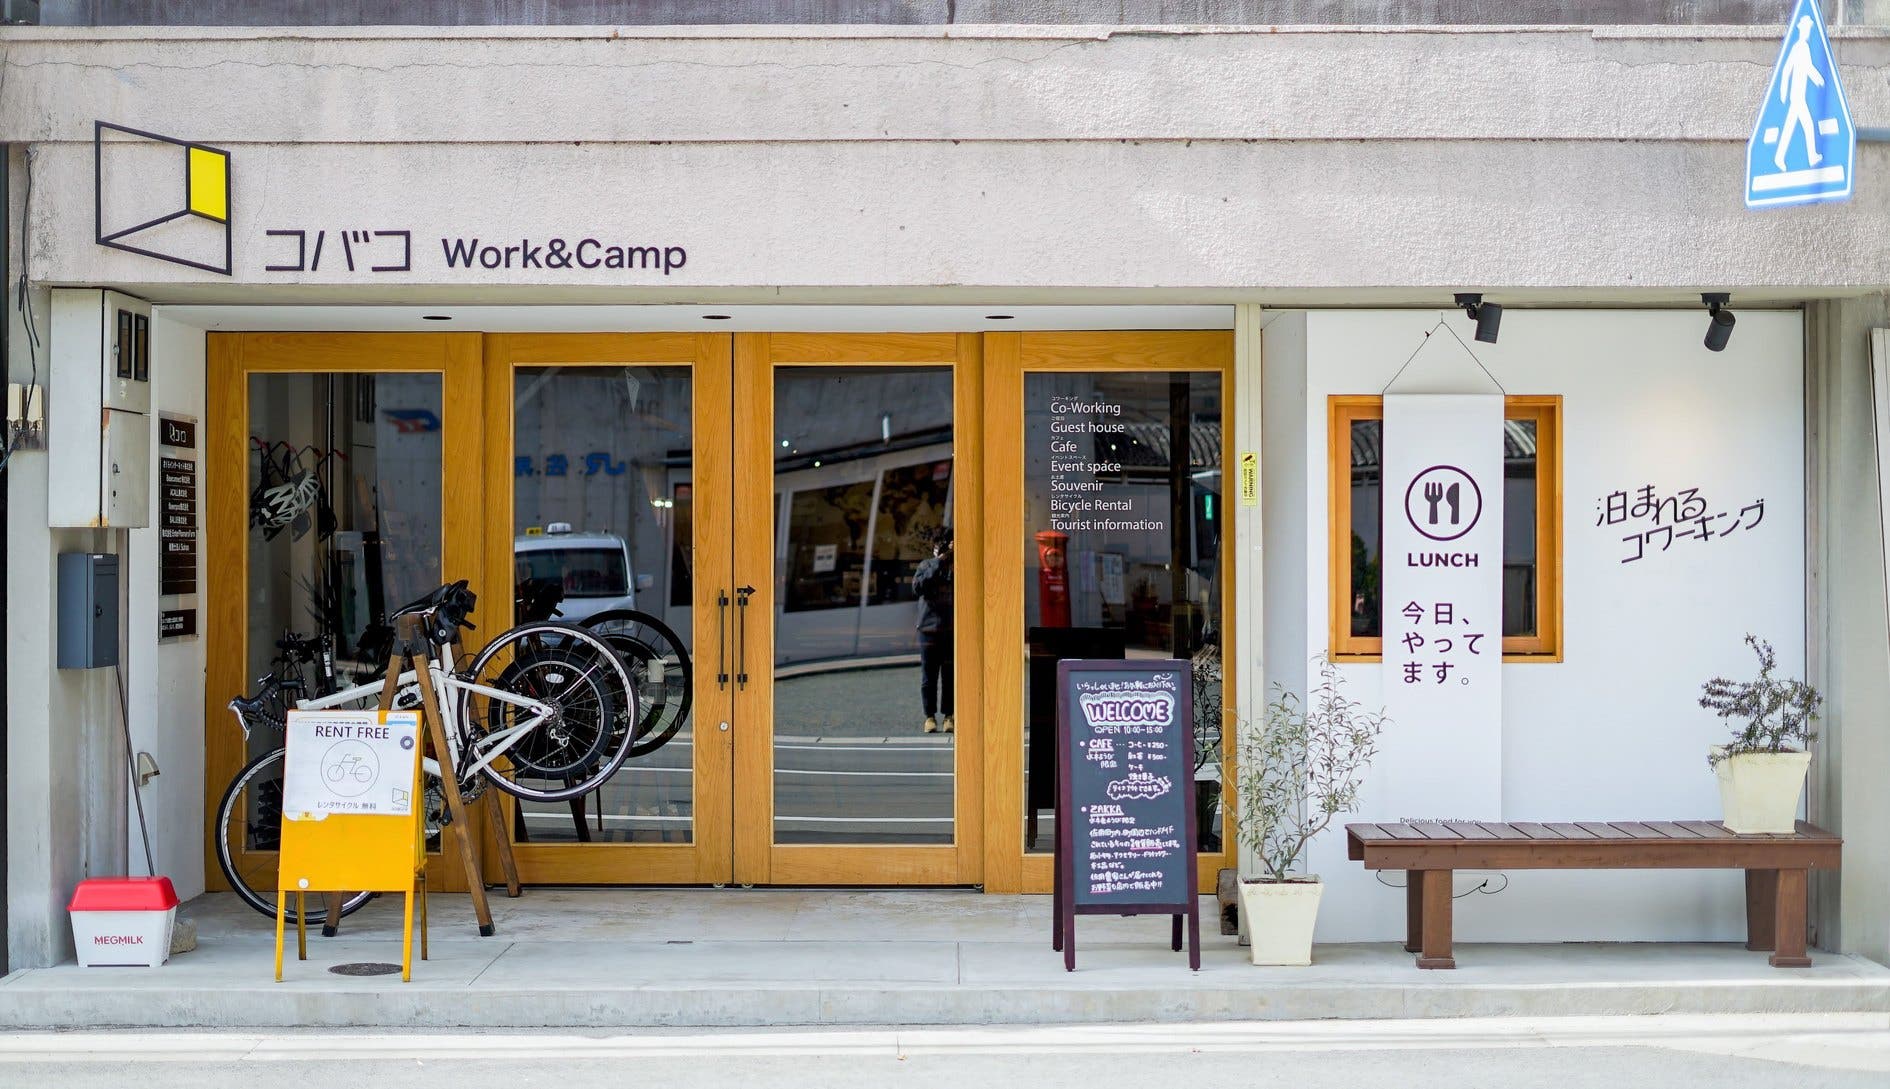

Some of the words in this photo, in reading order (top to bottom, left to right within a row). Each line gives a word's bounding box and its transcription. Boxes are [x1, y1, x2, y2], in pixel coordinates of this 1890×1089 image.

[266, 229, 411, 272] コバコ
[441, 237, 688, 275] Work&Camp
[1050, 402, 1121, 416] Co-Working
[1050, 421, 1085, 433] Guest
[1088, 421, 1125, 433] house
[1050, 441, 1077, 453] Cafe
[1051, 460, 1085, 472] Event
[1087, 462, 1121, 474] space
[1051, 480, 1104, 492] Souvenir
[1050, 499, 1092, 513] Bicycle
[1095, 499, 1132, 511] Rental
[1596, 484, 1707, 526] 泊まれる
[1051, 518, 1091, 531] Tourist
[1094, 518, 1163, 531] information
[1621, 498, 1765, 564] コワーキング
[1407, 552, 1479, 568] LUNCH
[1401, 600, 1470, 625] 今日、
[1401, 631, 1485, 655] やって
[1402, 661, 1470, 686] ます。
[1086, 700, 1169, 722] WELCOME
[315, 725, 353, 738] RENT
[357, 727, 390, 740] FREE
[1094, 726, 1120, 734] OPEN
[1089, 739, 1113, 749] CAFE
[317, 801, 359, 810] レンタサイクル
[361, 802, 377, 810] 無料
[1090, 805, 1123, 815] ZAKKA
[94, 936, 143, 945] MEGMILK
